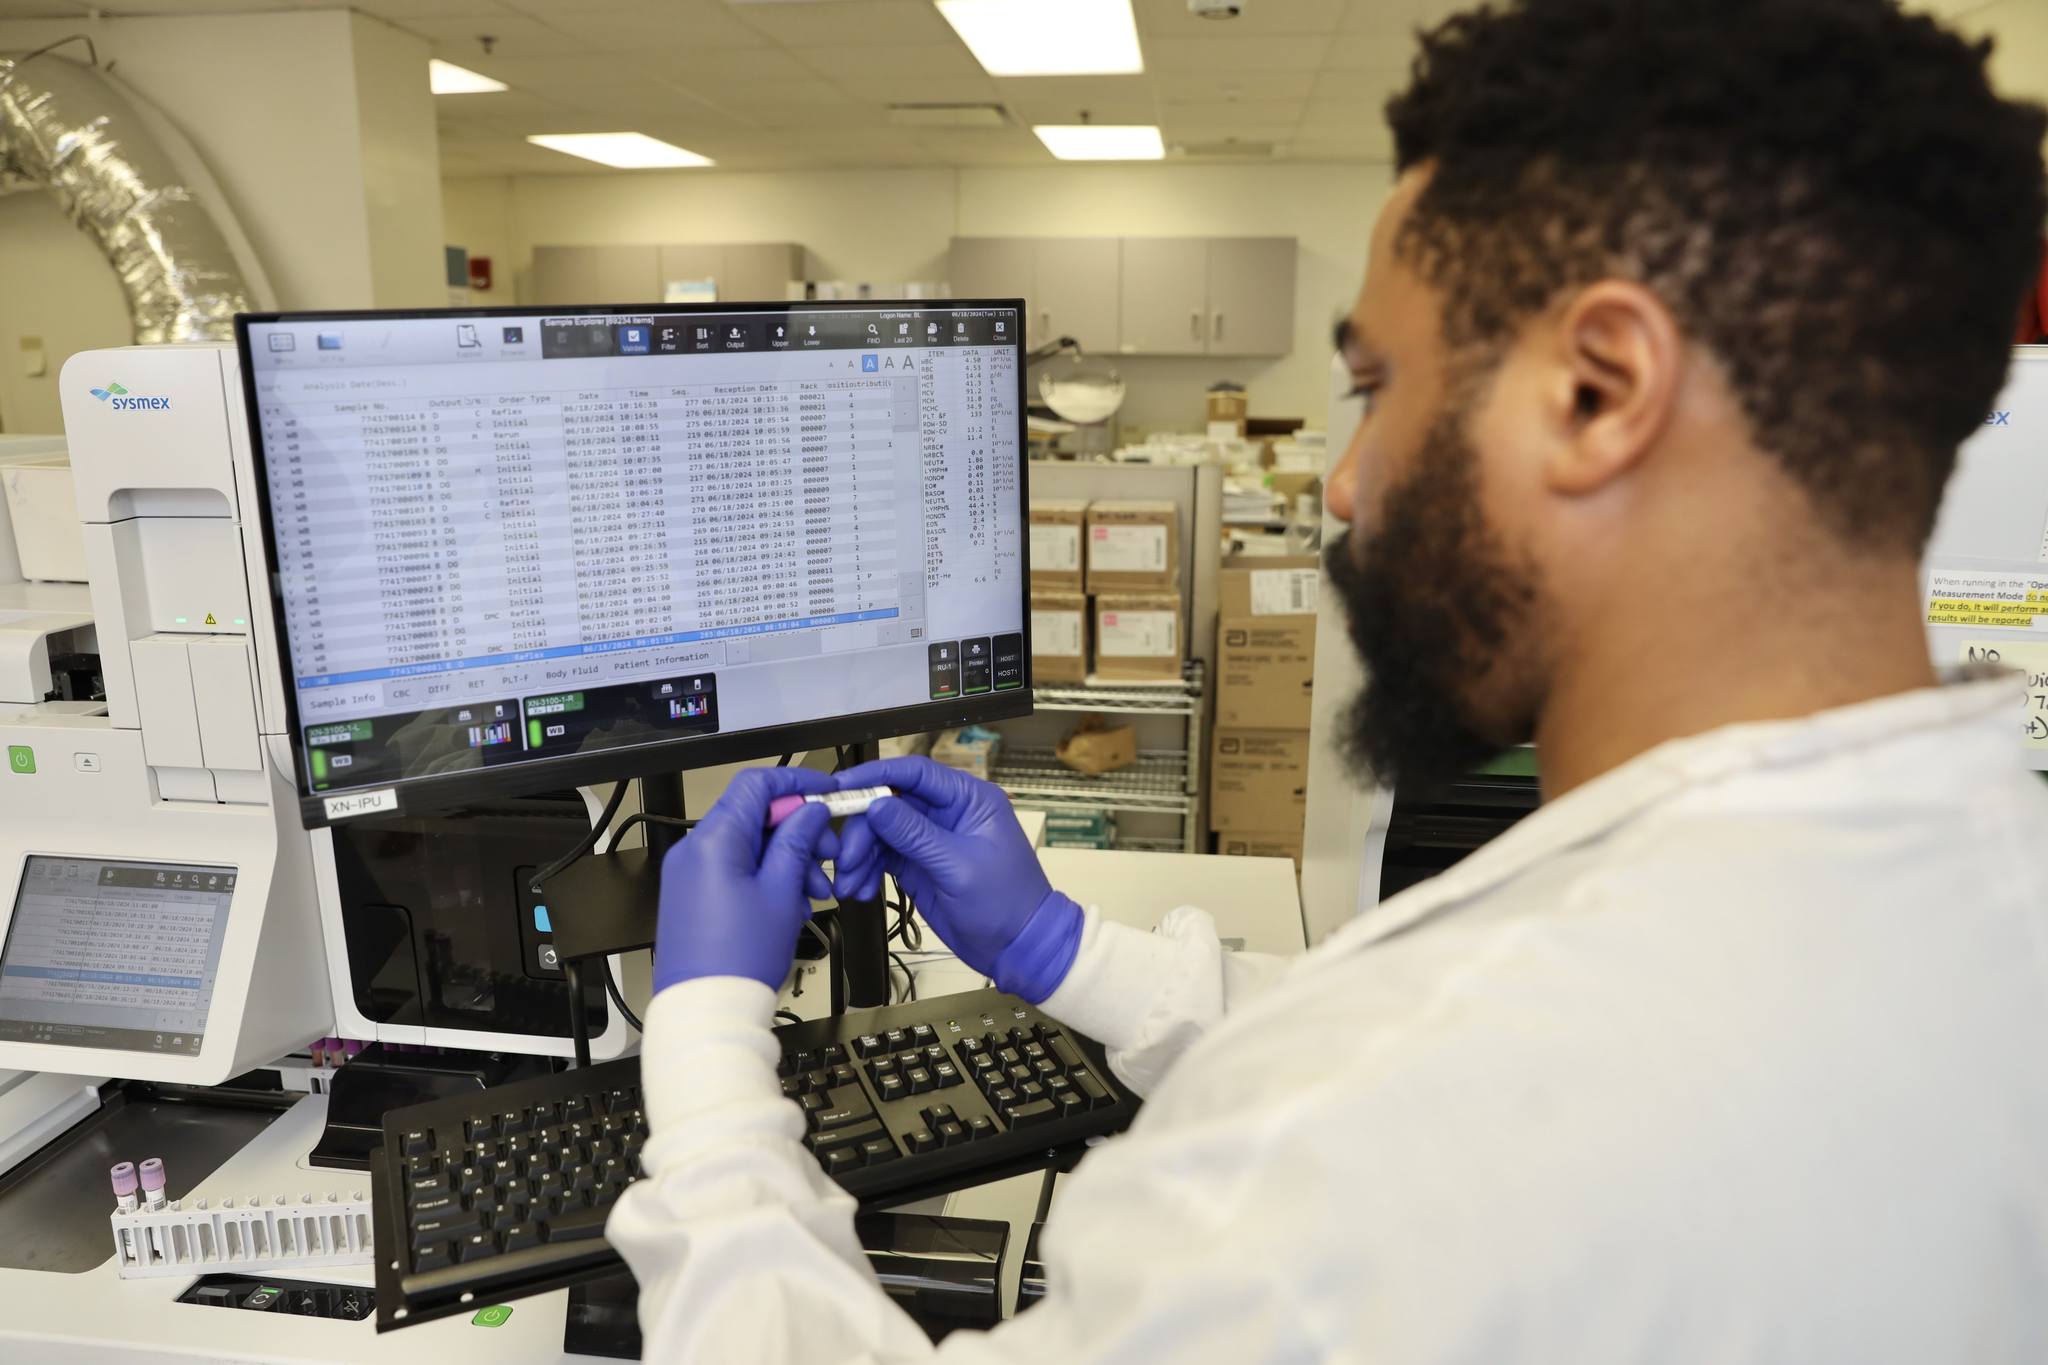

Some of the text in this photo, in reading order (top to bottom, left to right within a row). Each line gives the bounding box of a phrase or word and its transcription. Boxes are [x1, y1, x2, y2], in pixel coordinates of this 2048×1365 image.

[879, 312, 895, 320] Logon
[544, 318, 570, 327] Sample
[771, 339, 788, 348] Upper
[803, 338, 820, 346] Lower
[893, 336, 904, 344] Last
[927, 335, 937, 343] File
[952, 334, 969, 342] Delete
[660, 342, 676, 350] Filter
[695, 341, 709, 349] Sort
[725, 341, 745, 349] Output
[847, 359, 854, 369] A
[865, 357, 874, 369] A
[884, 355, 894, 368] A
[901, 354, 913, 369] A
[333, 402, 368, 413] Sample
[427, 398, 461, 408] Output
[498, 395, 526, 404] Order
[530, 394, 551, 404] Type
[578, 391, 599, 400] Date
[629, 389, 649, 397] Time
[671, 388, 689, 396] Seq.
[713, 384, 755, 394] Reception
[758, 383, 777, 392] Date
[800, 382, 818, 390] Rack
[112, 397, 170, 410] sysmex
[702, 407, 748, 417] 06/18/2024
[494, 440, 530, 451] Initial
[703, 428, 750, 438] 06/18/2024
[707, 491, 753, 502] 06/18/2024
[708, 512, 754, 524] 06/18/2024
[710, 533, 755, 544] 06/18/2024
[711, 553, 756, 565] 06/18/2024
[1934, 577, 1960, 585] When
[1962, 578, 1996, 589] running
[1999, 579, 2007, 587] in
[2009, 579, 2024, 588] the
[509, 596, 545, 607] Initial
[712, 574, 757, 586] 06/18/2024
[1932, 589, 1995, 599] Measurement
[1996, 592, 2023, 601] Mode
[2026, 593, 2037, 601] do
[1938, 603, 1955, 611] you
[1957, 602, 1971, 612] do,
[2001, 605, 2038, 614] perform
[1928, 614, 2034, 626] results will be reported.
[999, 654, 1015, 662] HOST
[1968, 646, 2000, 663] NO
[936, 662, 952, 671] RU-1
[968, 658, 984, 667] Printer
[997, 667, 1017, 678] HOST1
[308, 650, 710, 710] Sample Info CBC DIFF RET PLT-F Body Fluid Patient Information
[526, 694, 574, 708] XN-3100-1-R
[548, 726, 563, 735] WB
[333, 755, 350, 766] WB
[330, 796, 382, 813] XN-IPU
[416, 1198, 449, 1209] Caps Lock
